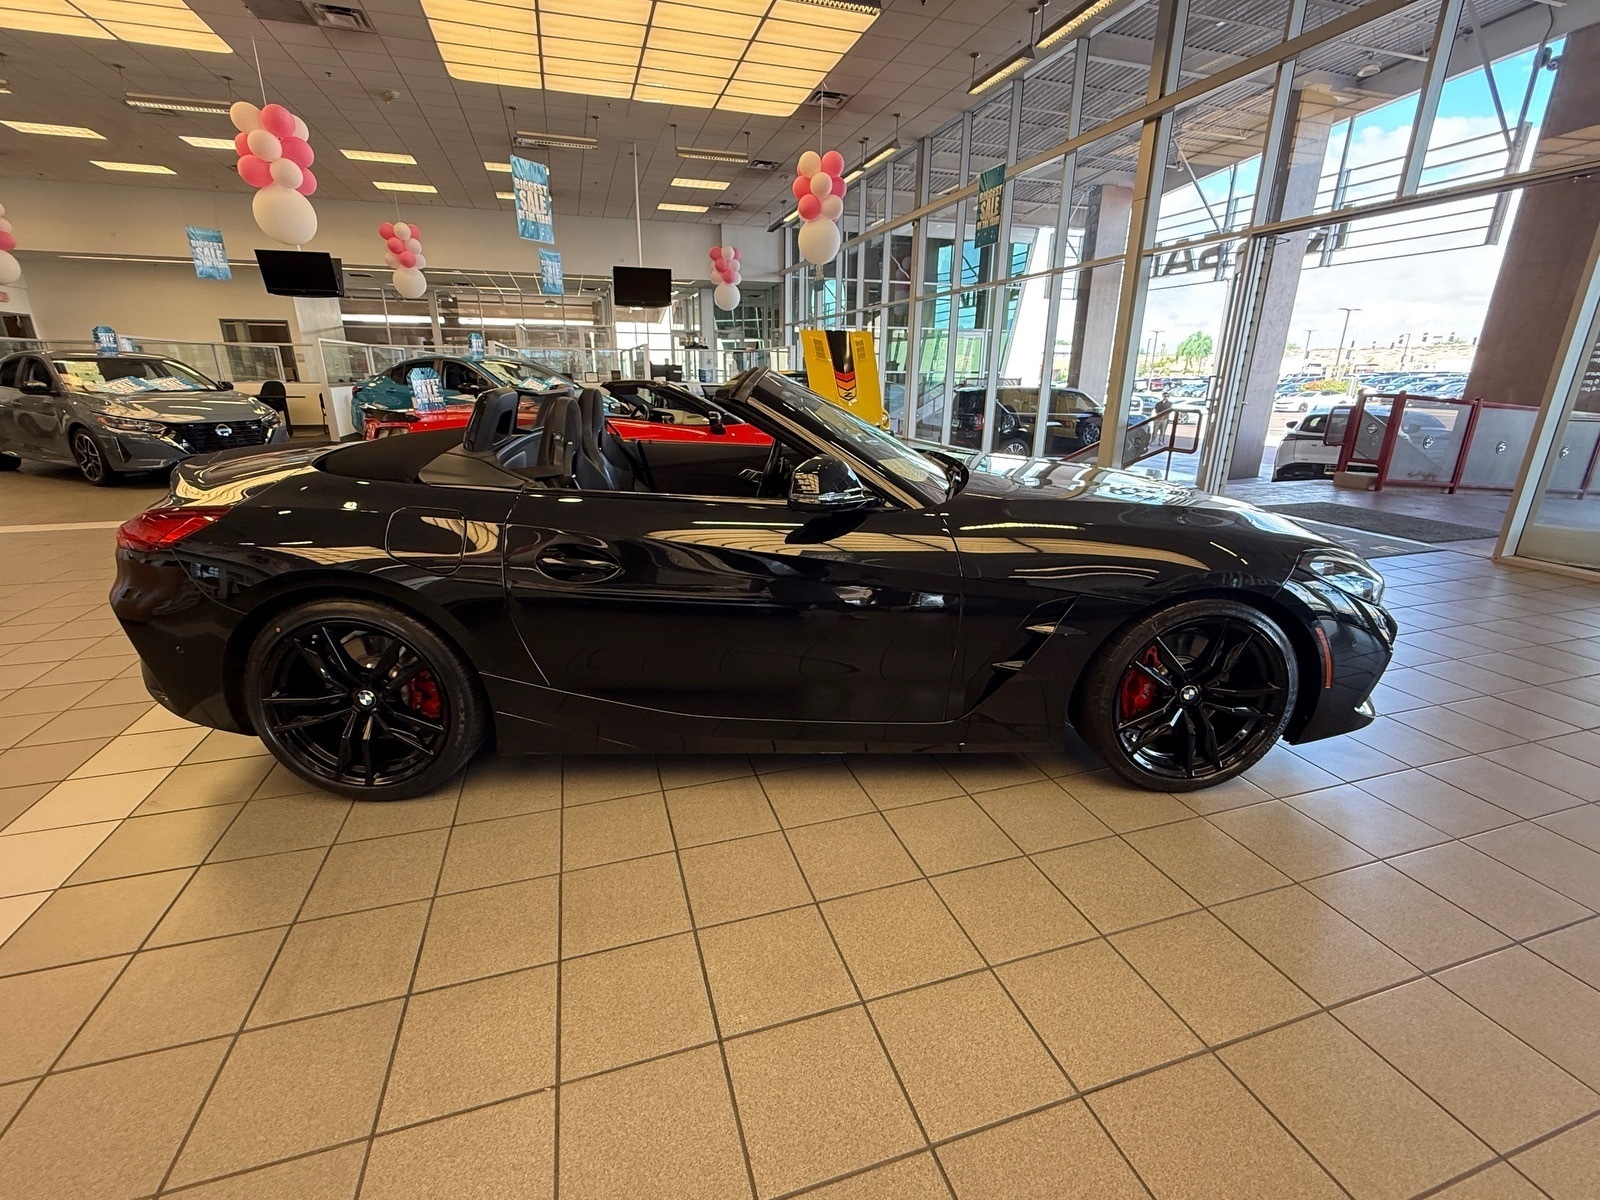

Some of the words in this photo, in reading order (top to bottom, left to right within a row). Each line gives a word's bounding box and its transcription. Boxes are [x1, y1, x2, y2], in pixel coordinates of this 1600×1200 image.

[514, 177, 548, 197] BIGGEST
[979, 183, 1004, 204] BIGGEST
[518, 189, 548, 214] SALE
[980, 196, 1000, 221] SALE
[518, 209, 526, 219] OF
[525, 211, 537, 222] THE
[190, 239, 224, 250] BIGGEST
[195, 247, 224, 262] SALE
[543, 266, 562, 279] SALE
[416, 385, 440, 399] SALE
